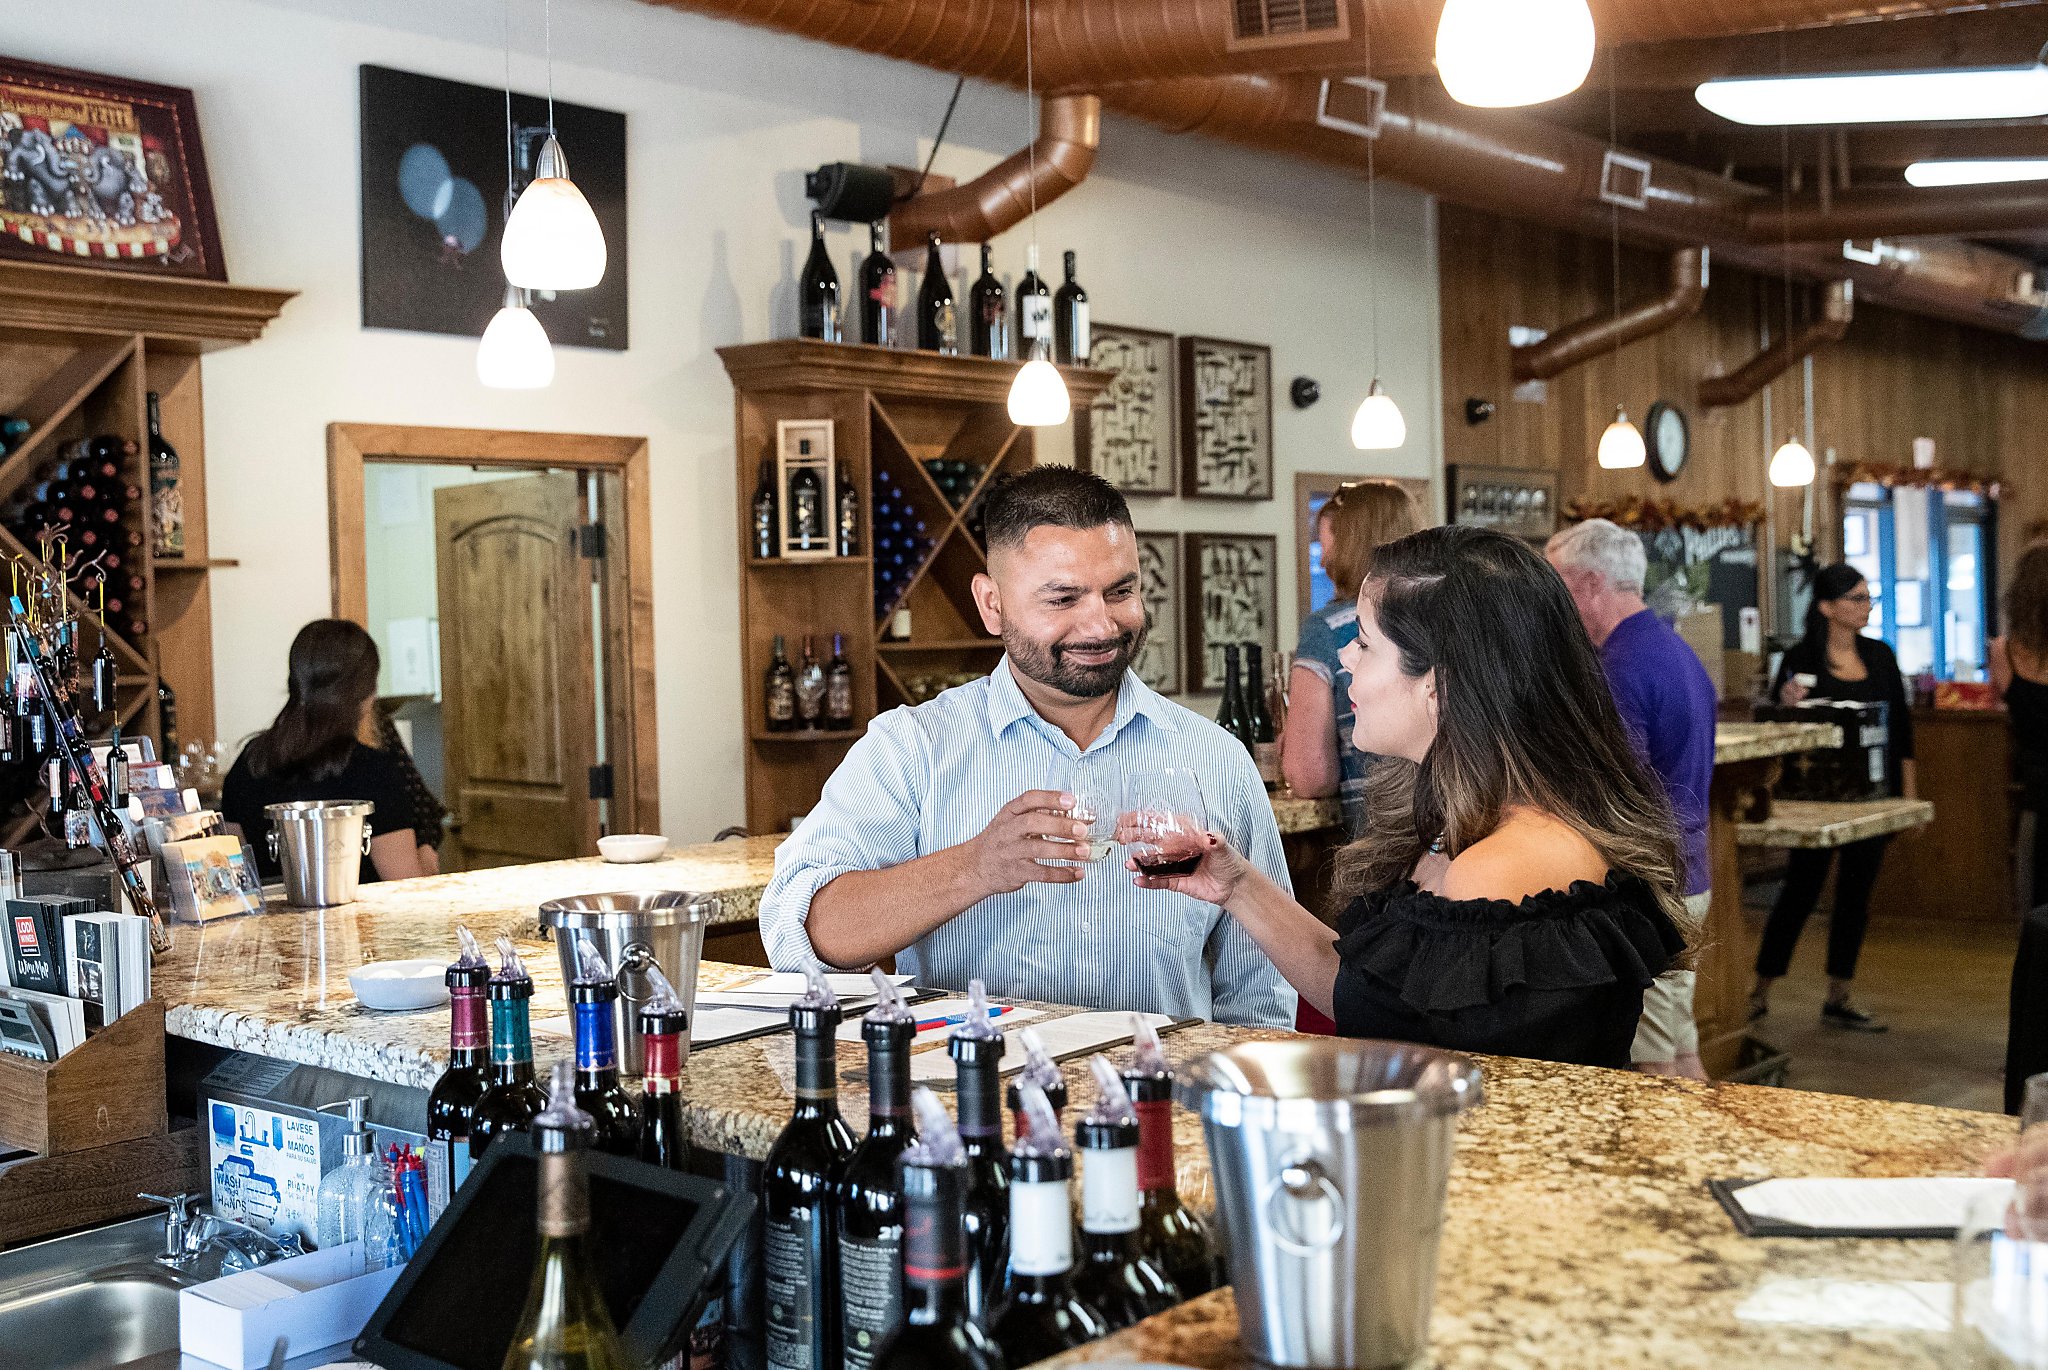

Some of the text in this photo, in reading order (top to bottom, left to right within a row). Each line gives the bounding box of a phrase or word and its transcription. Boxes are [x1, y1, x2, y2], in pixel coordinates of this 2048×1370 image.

[17, 921, 33, 934] LODI
[20, 934, 36, 943] WINES
[286, 1120, 313, 1135] LAVESE
[287, 1140, 314, 1155] MANOS
[217, 1172, 241, 1188] WASH
[217, 1194, 247, 1212] HANDS
